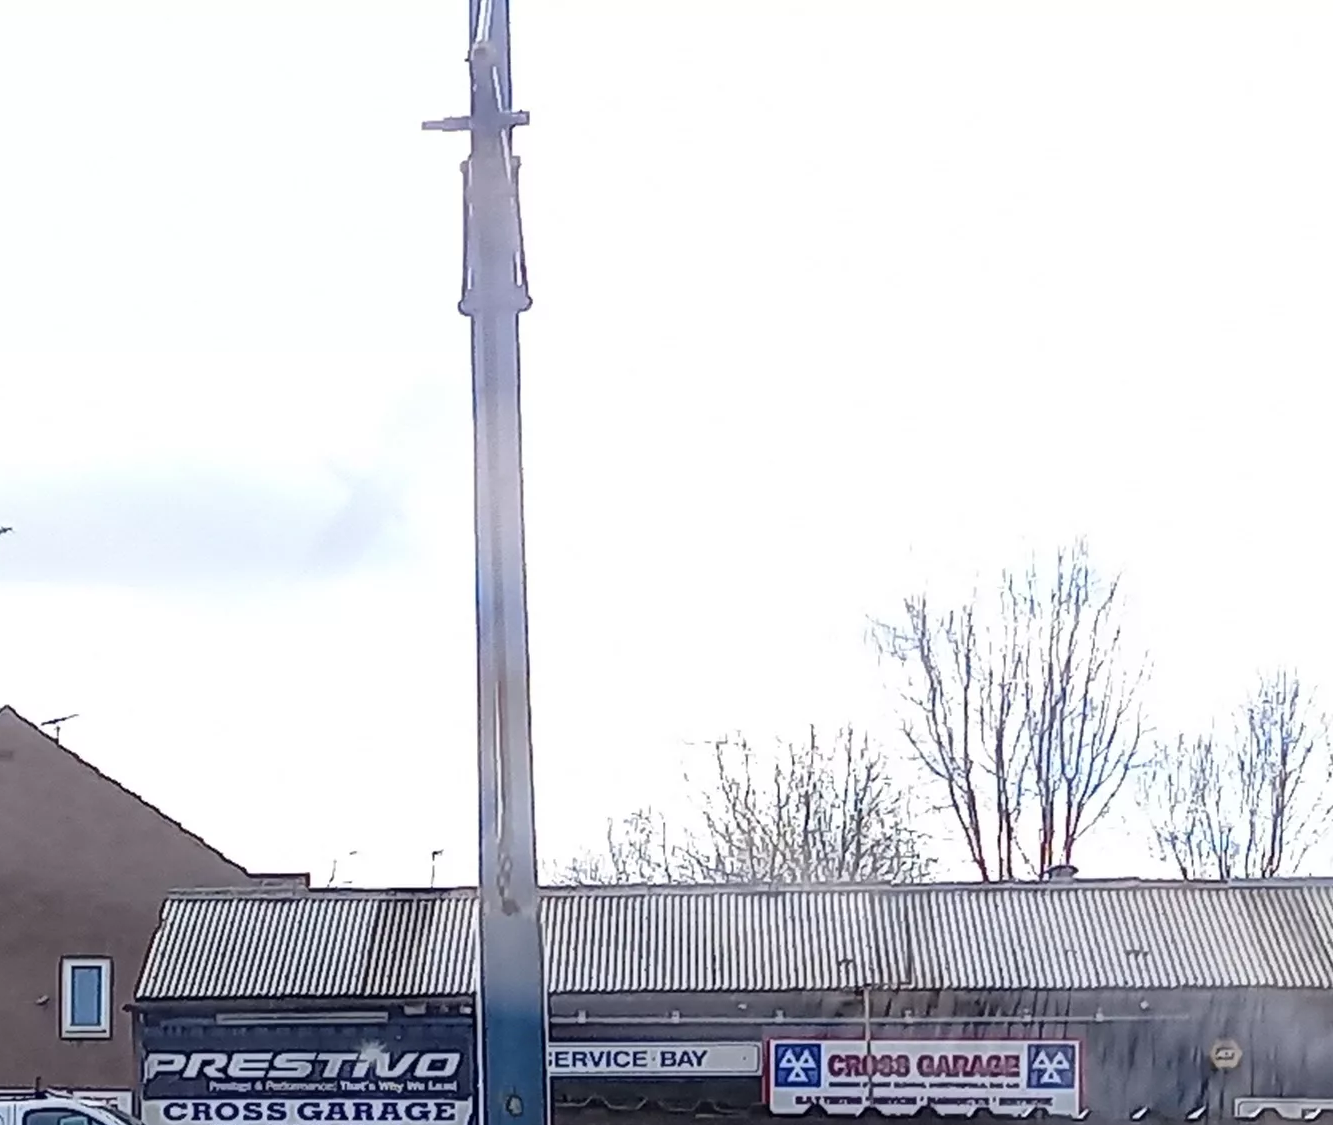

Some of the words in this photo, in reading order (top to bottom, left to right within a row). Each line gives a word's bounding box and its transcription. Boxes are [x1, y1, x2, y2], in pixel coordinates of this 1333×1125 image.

[660, 1050, 709, 1068] BAY
[827, 1054, 911, 1078] CROSS
[916, 1054, 1021, 1078] GARAGE
[162, 1102, 288, 1121] CROSS
[296, 1102, 456, 1121] GARAGE
